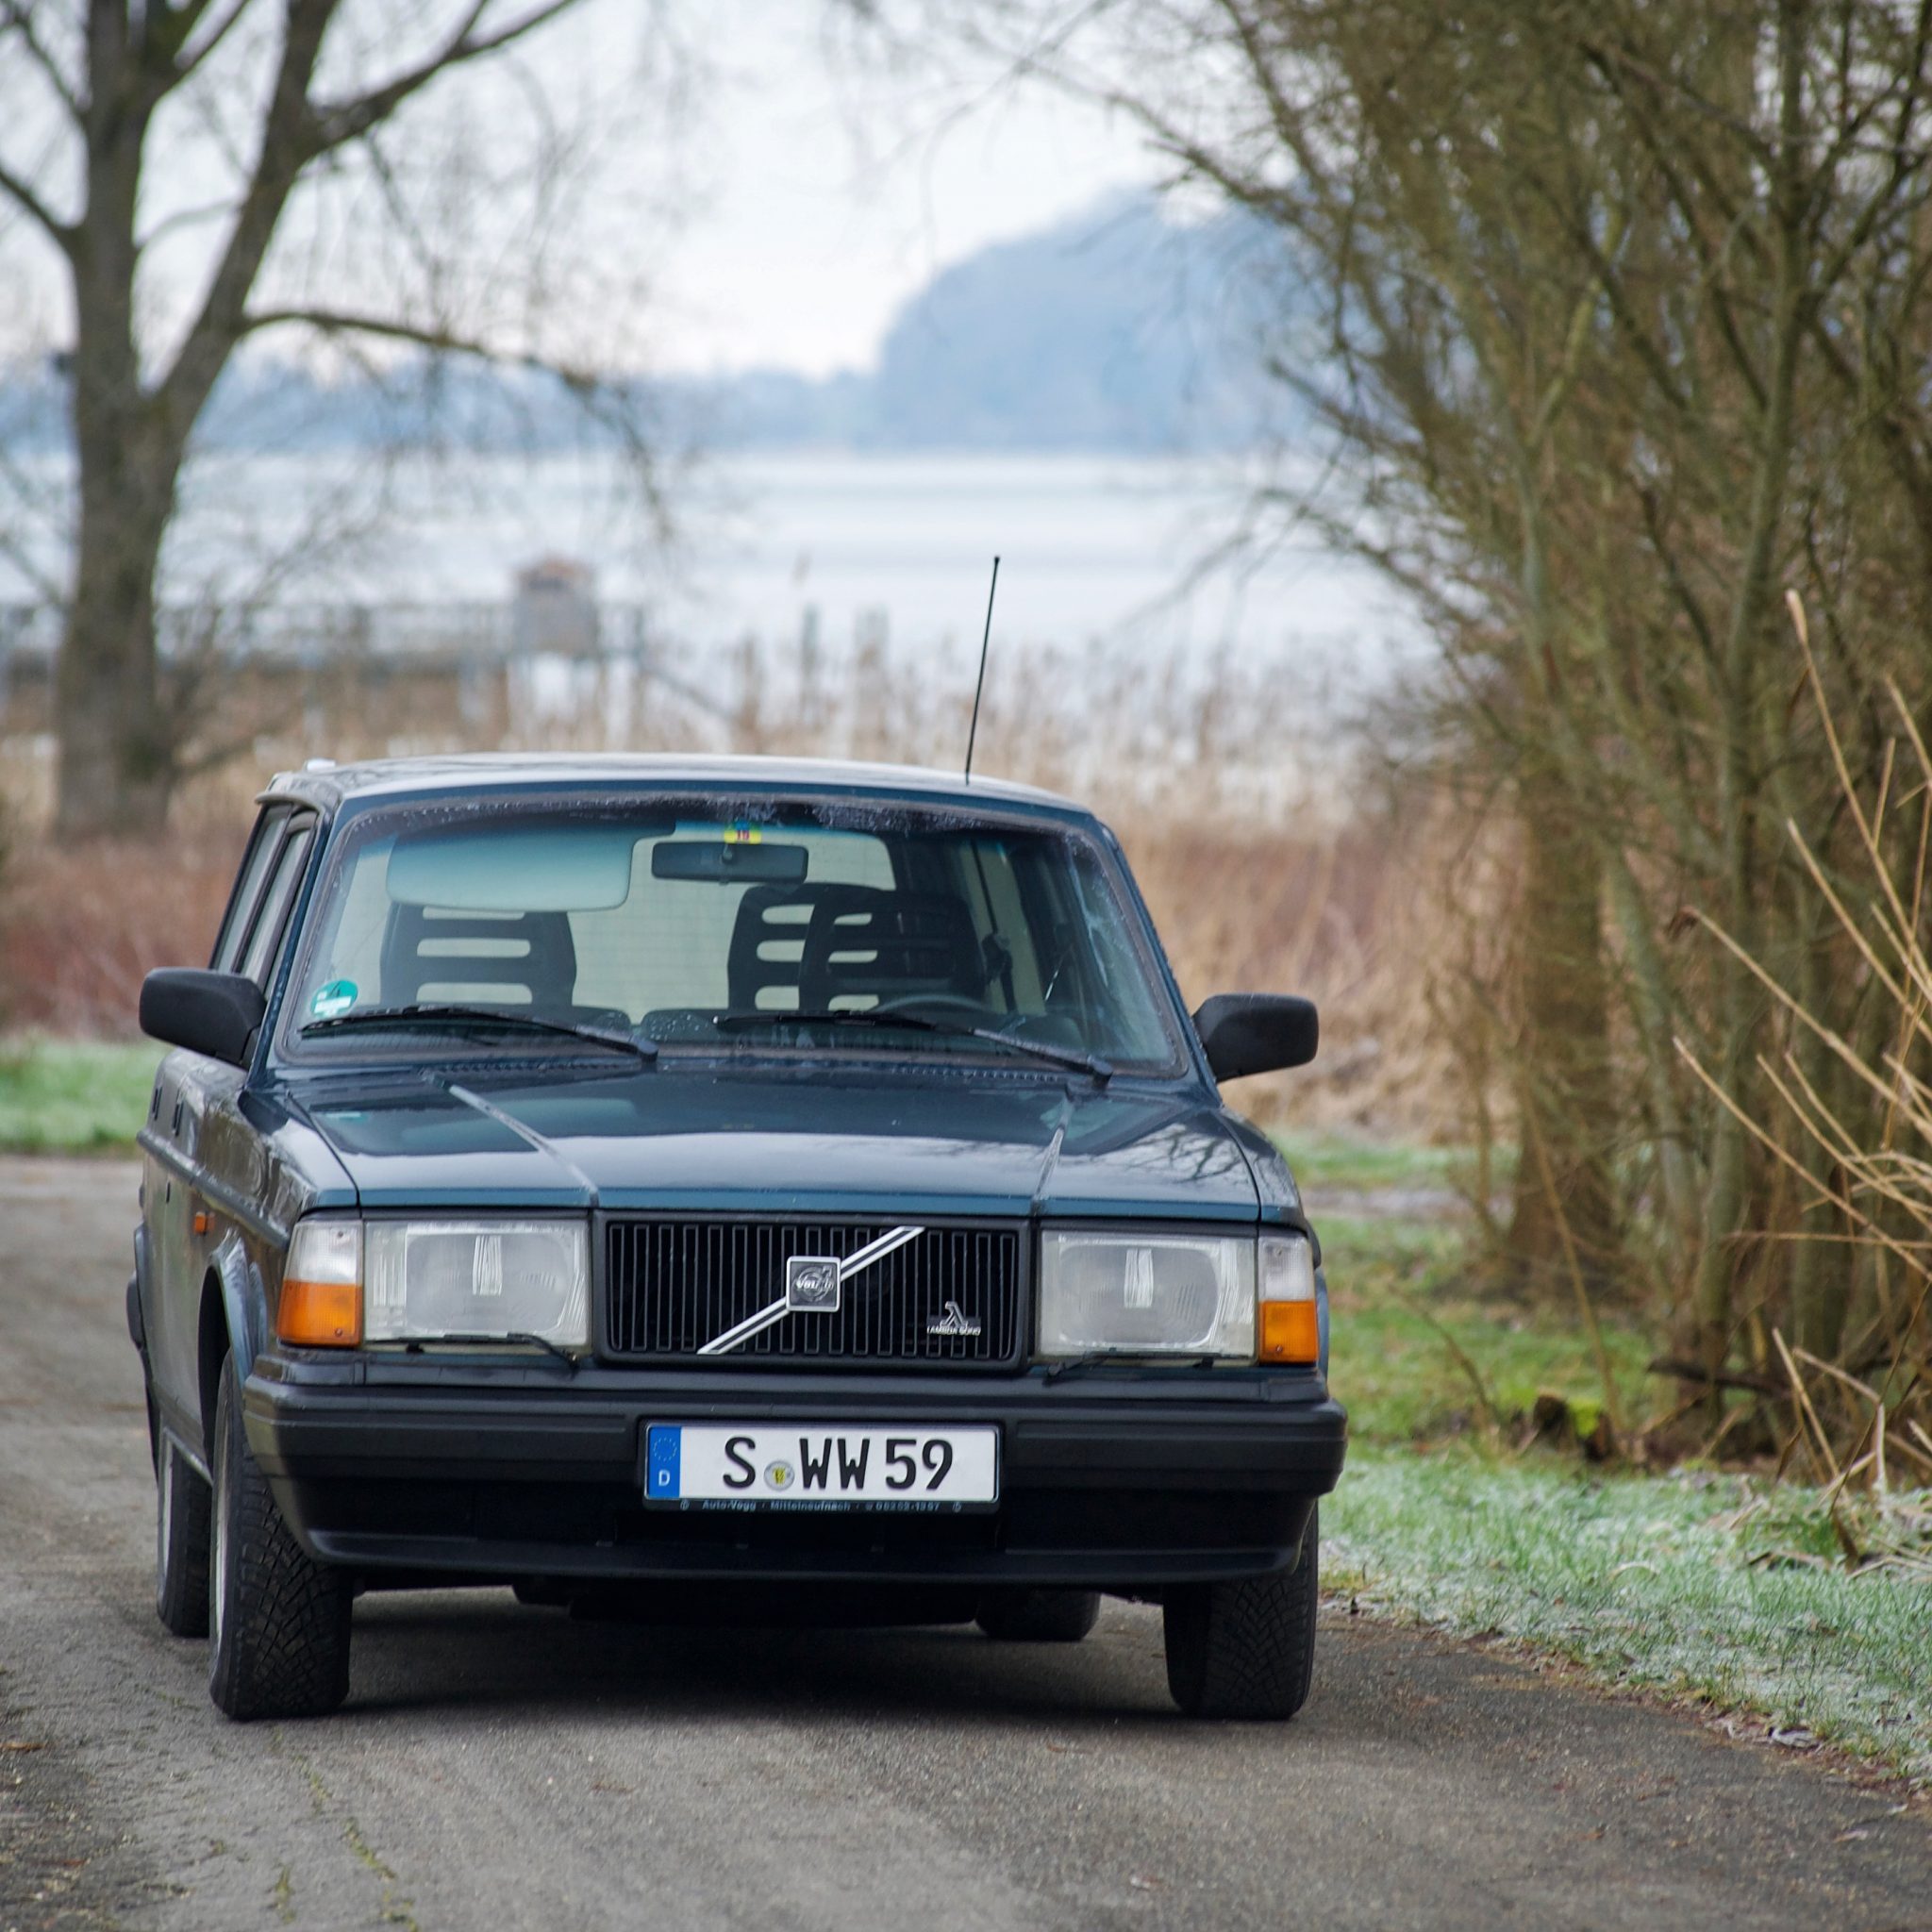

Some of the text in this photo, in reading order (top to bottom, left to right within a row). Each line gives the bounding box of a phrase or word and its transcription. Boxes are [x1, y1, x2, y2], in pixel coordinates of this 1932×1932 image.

[658, 1470, 671, 1486] D
[723, 1436, 757, 1490] S
[885, 1438, 954, 1491] 59
